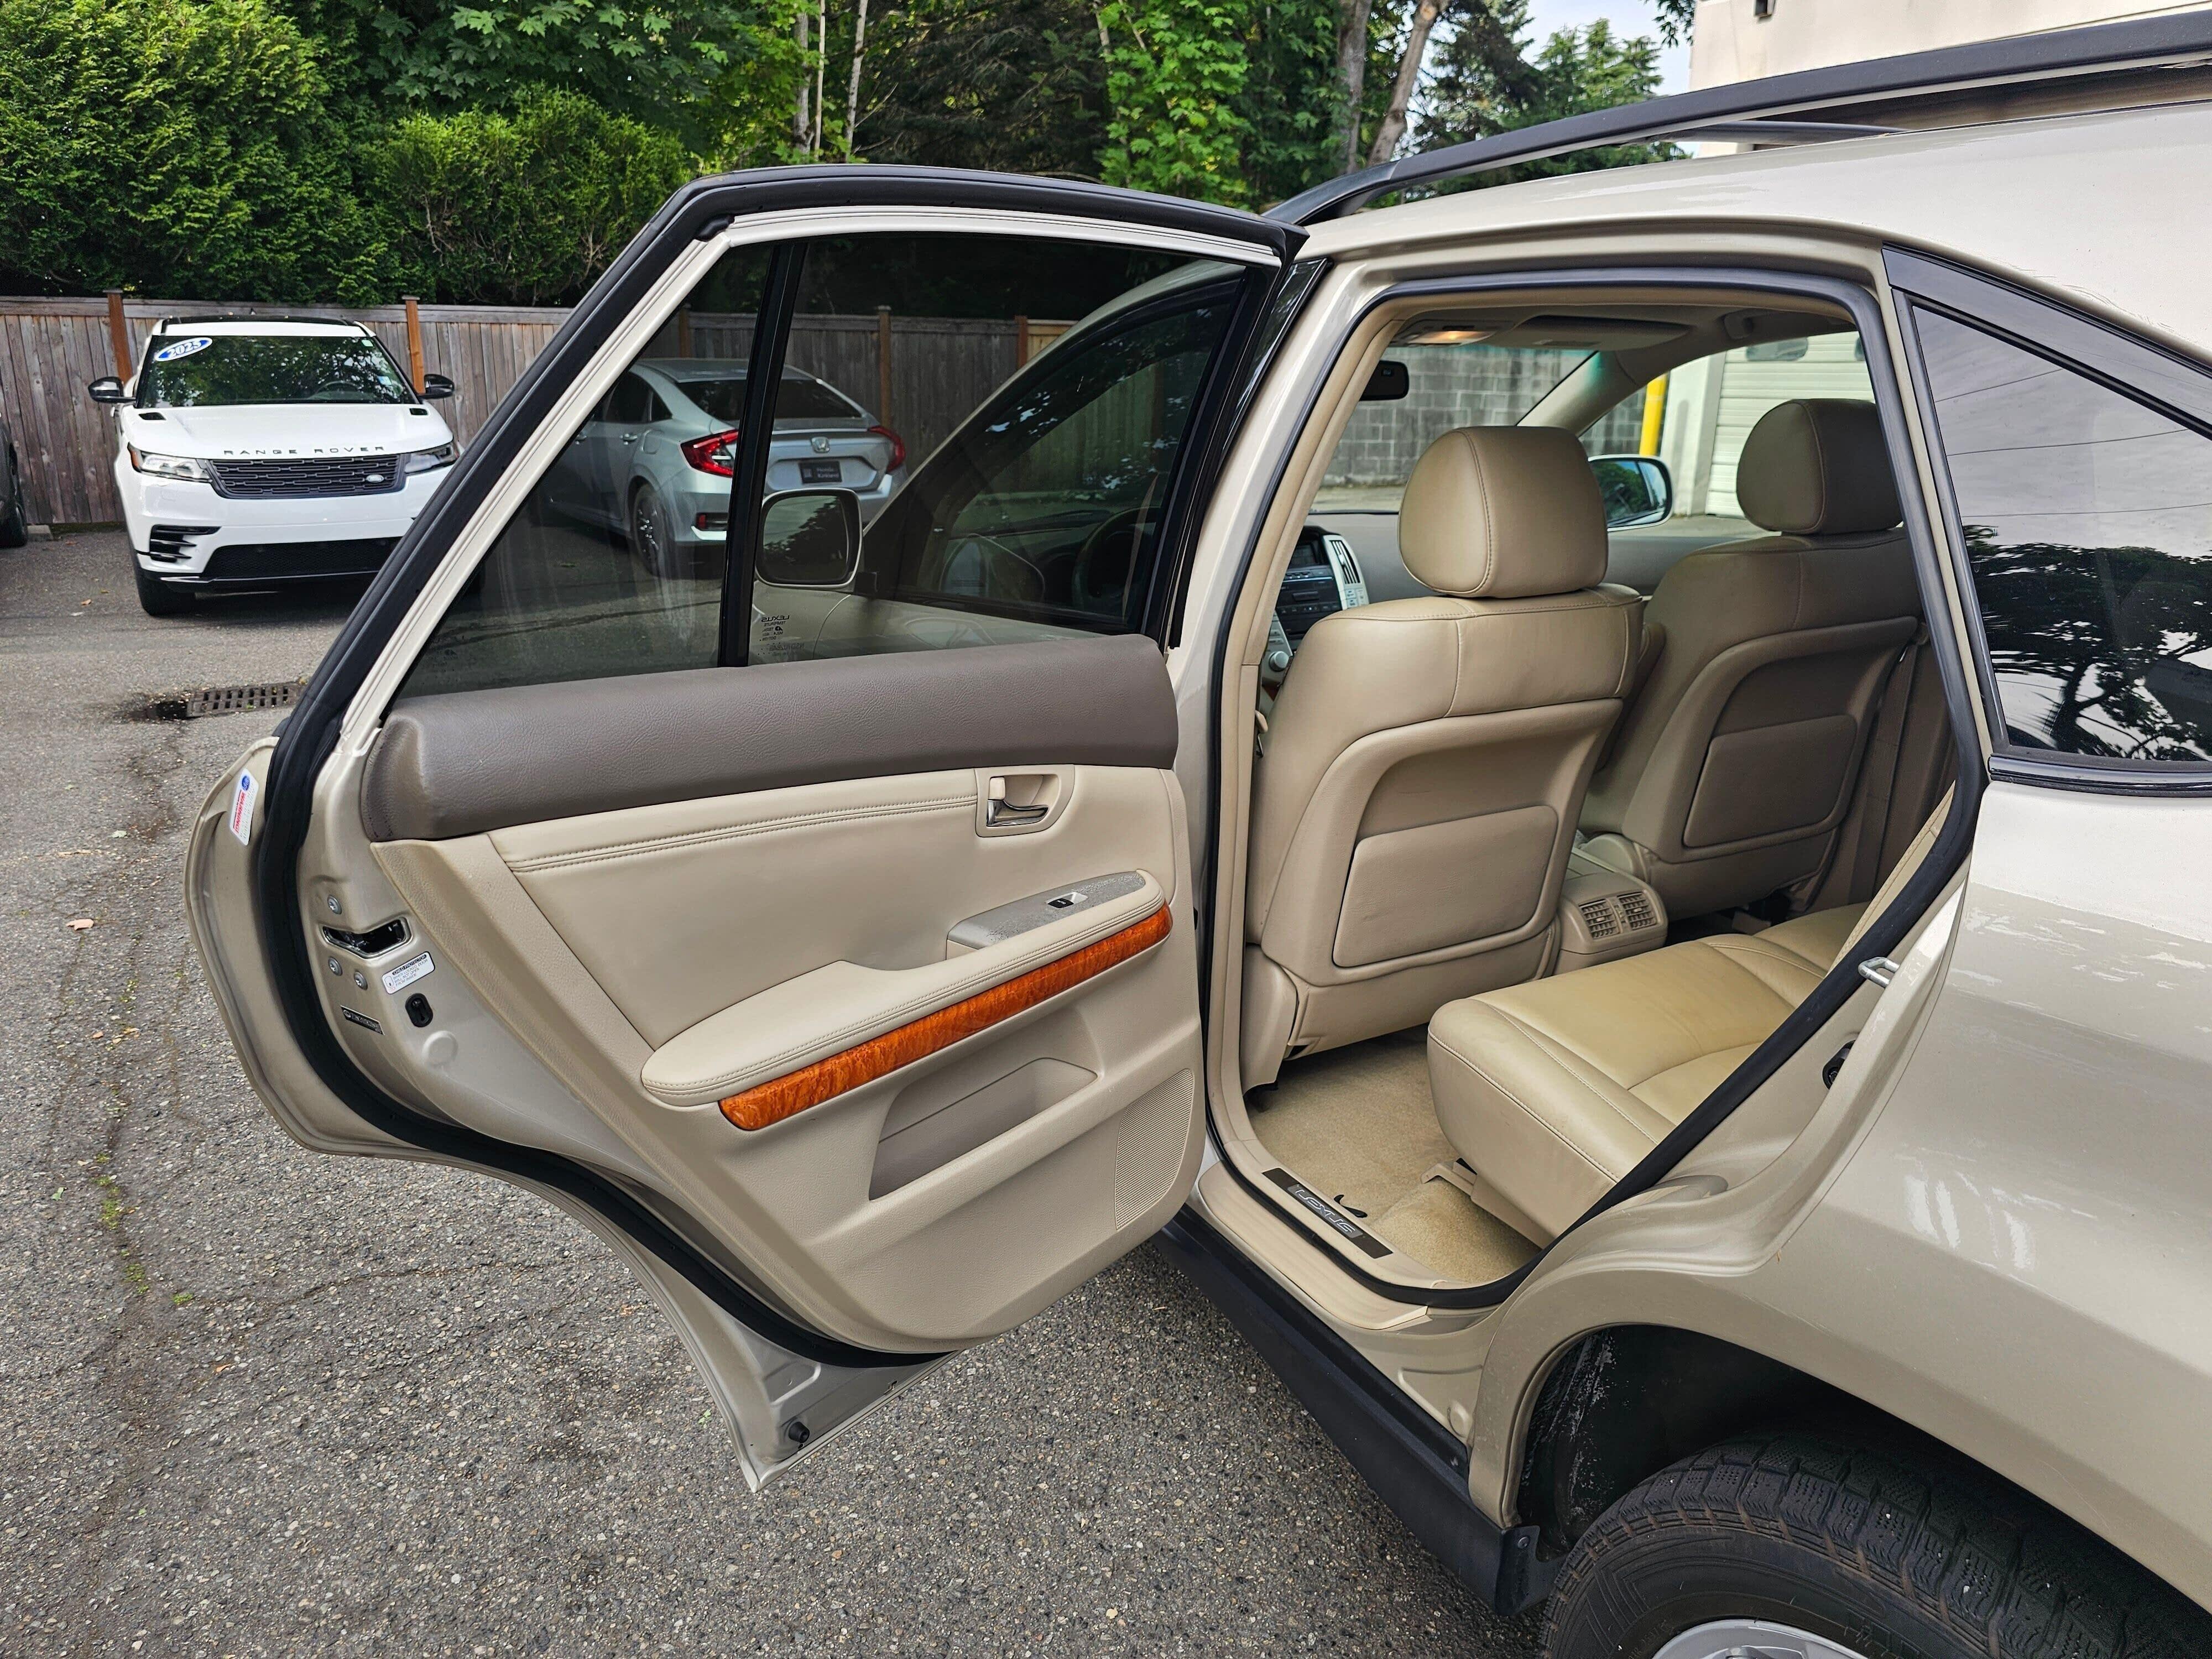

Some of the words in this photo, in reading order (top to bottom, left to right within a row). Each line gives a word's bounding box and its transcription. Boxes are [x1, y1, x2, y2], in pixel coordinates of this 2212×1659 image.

[166, 341, 202, 358] 2025
[234, 791, 247, 834] WARNING!
[1295, 1188, 1356, 1234] LEXUS
